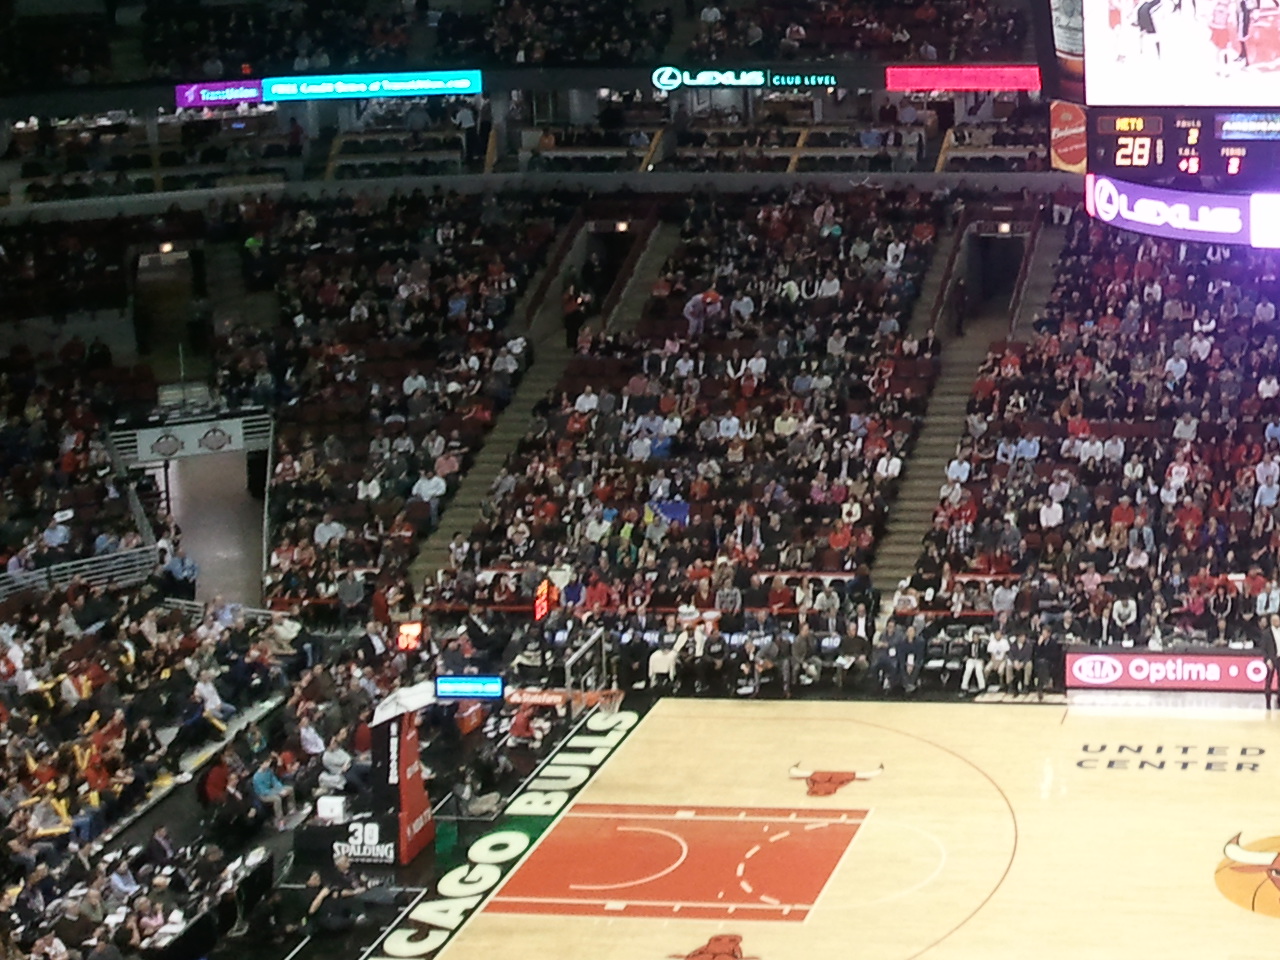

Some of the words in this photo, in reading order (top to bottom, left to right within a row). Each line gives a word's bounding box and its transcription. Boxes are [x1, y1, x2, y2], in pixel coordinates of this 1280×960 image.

[682, 70, 765, 86] LEXUS
[773, 75, 801, 86] CLUB
[803, 75, 836, 86] LEVEL
[1115, 136, 1151, 166] 28
[1119, 193, 1242, 234] LEXUS
[1129, 658, 1220, 683] Optima
[1081, 744, 1266, 757] UNITED
[504, 710, 640, 816] BULLS
[1076, 759, 1260, 772] CENTER
[348, 822, 379, 846] 30
[333, 841, 394, 859] SPALDING
